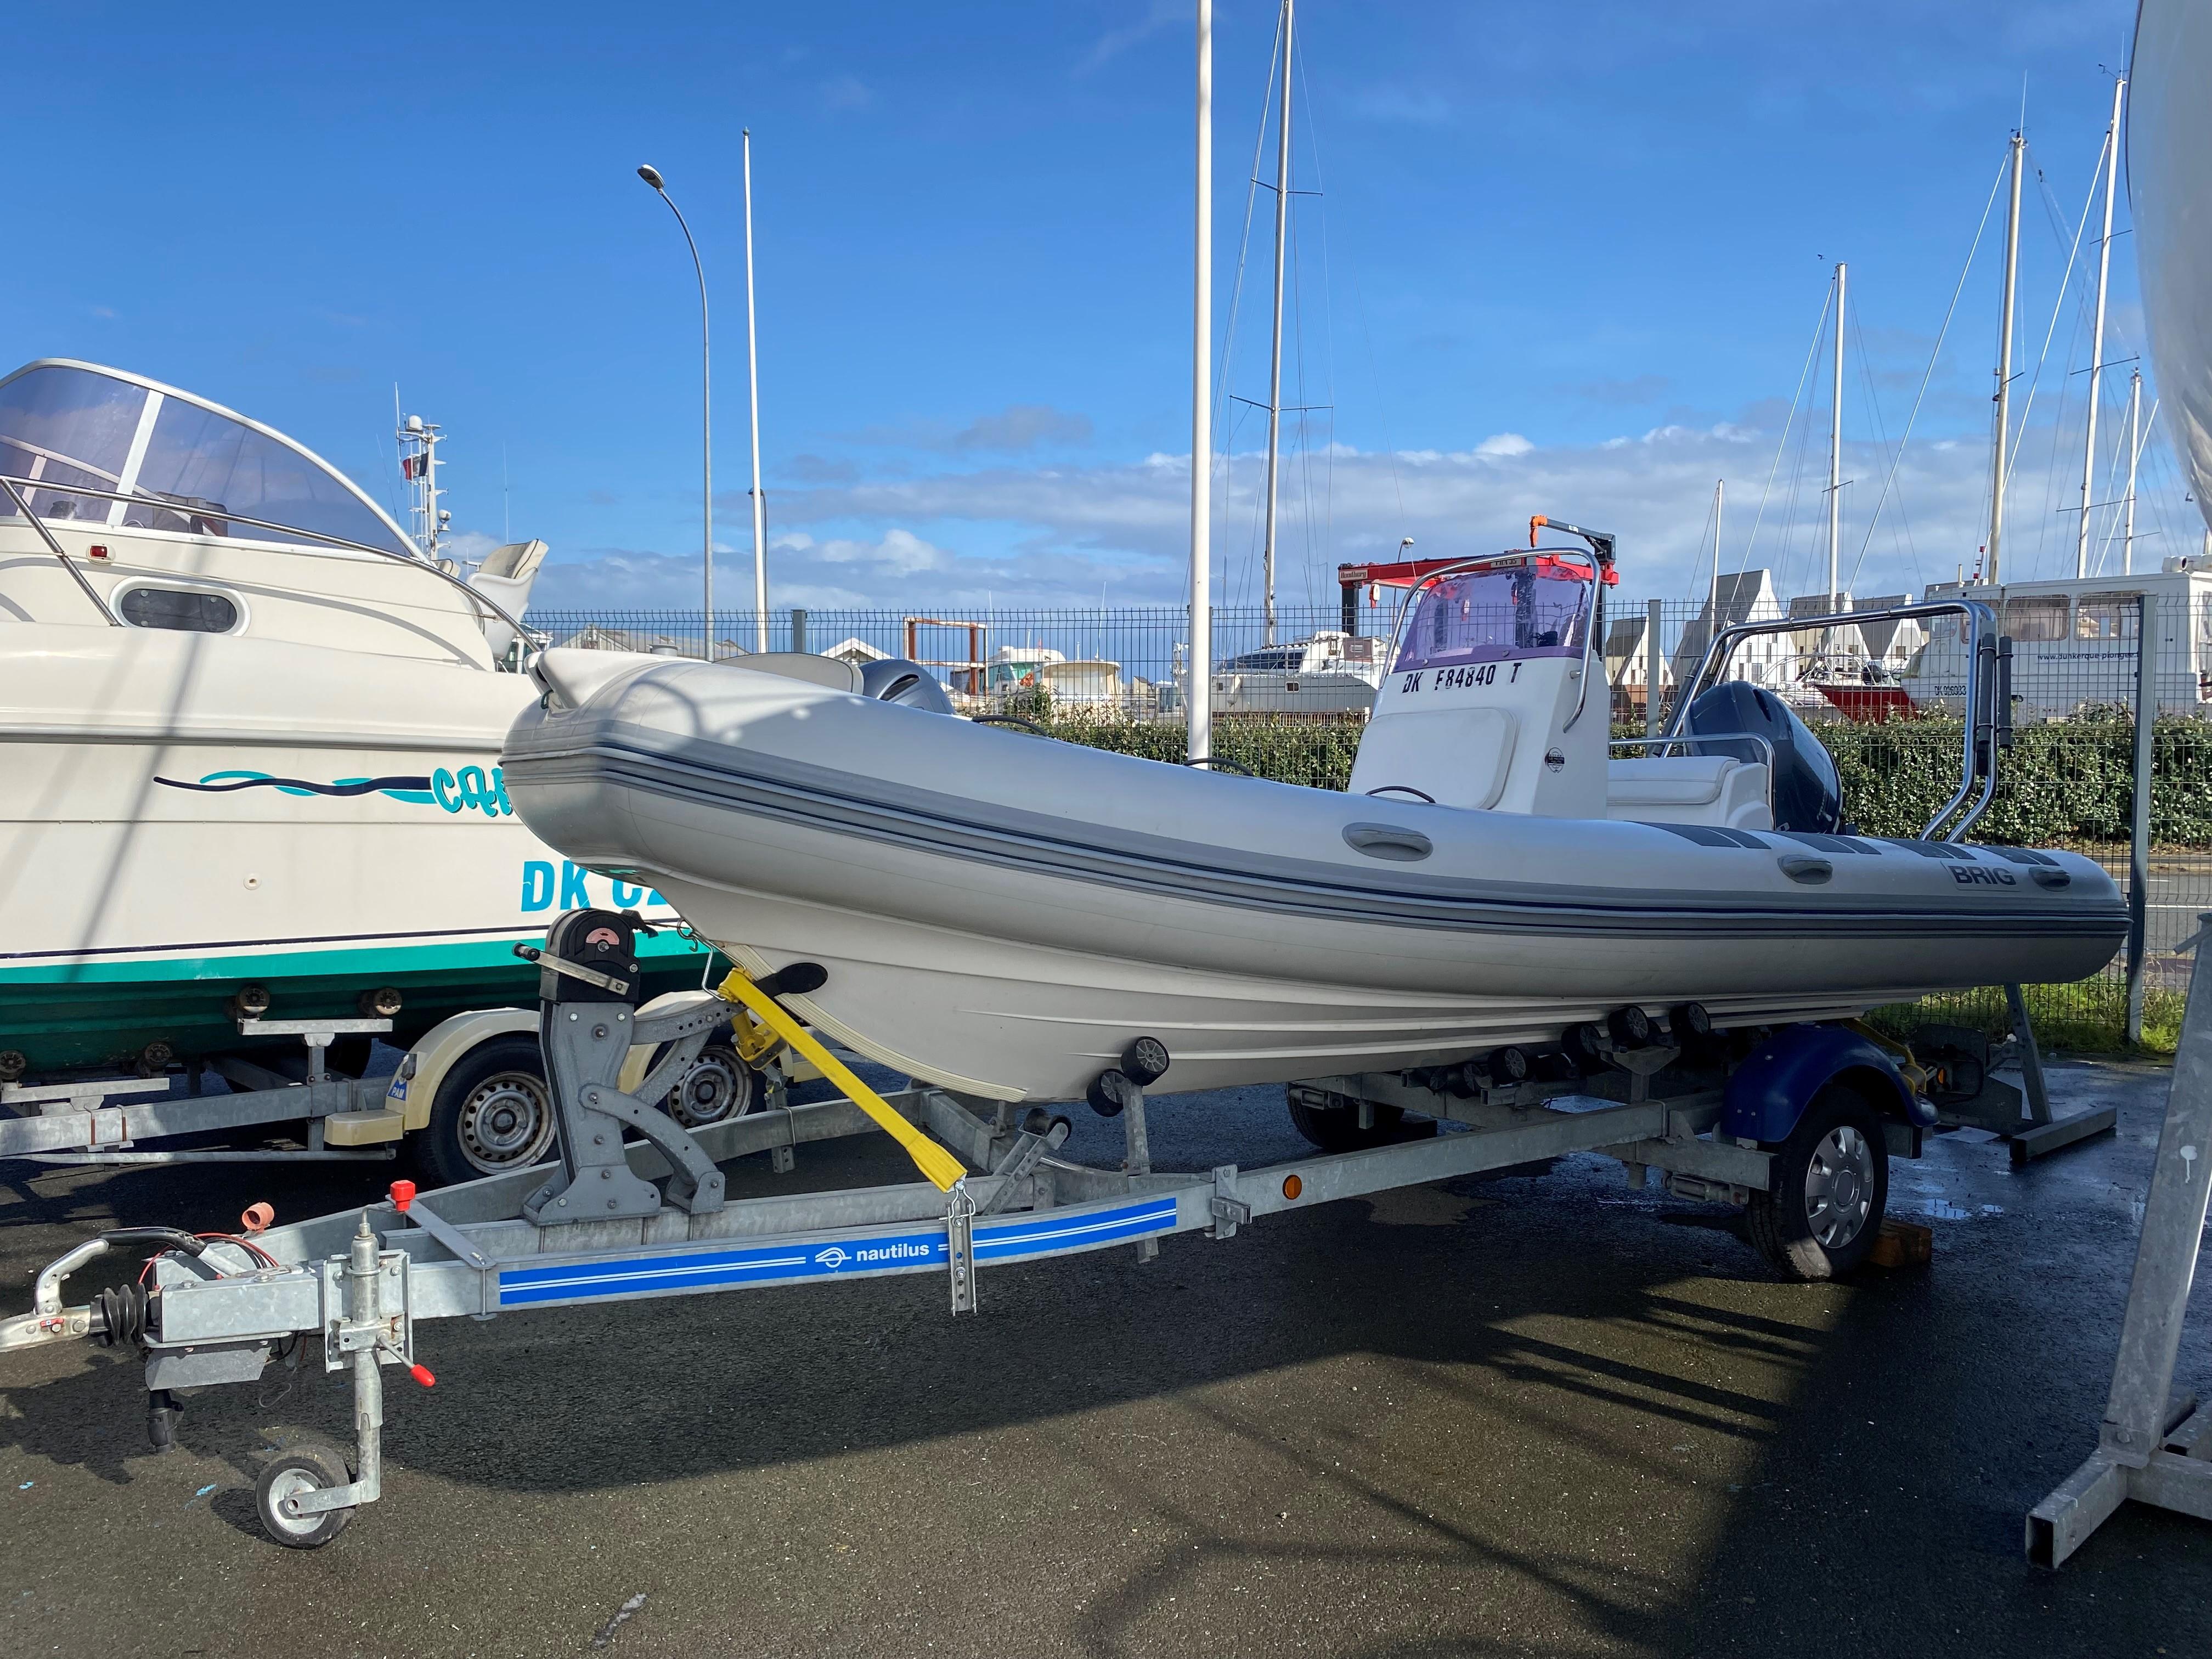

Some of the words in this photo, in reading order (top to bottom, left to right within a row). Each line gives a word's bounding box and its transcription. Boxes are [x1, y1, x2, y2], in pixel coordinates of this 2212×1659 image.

[1402, 672, 1424, 693] DK
[1435, 664, 1496, 691] F84840
[1511, 662, 1522, 684] T
[1948, 865, 2016, 885] BRIG
[521, 860, 591, 912] DK
[391, 1086, 405, 1099] PAM
[856, 1243, 930, 1262] nautilus
